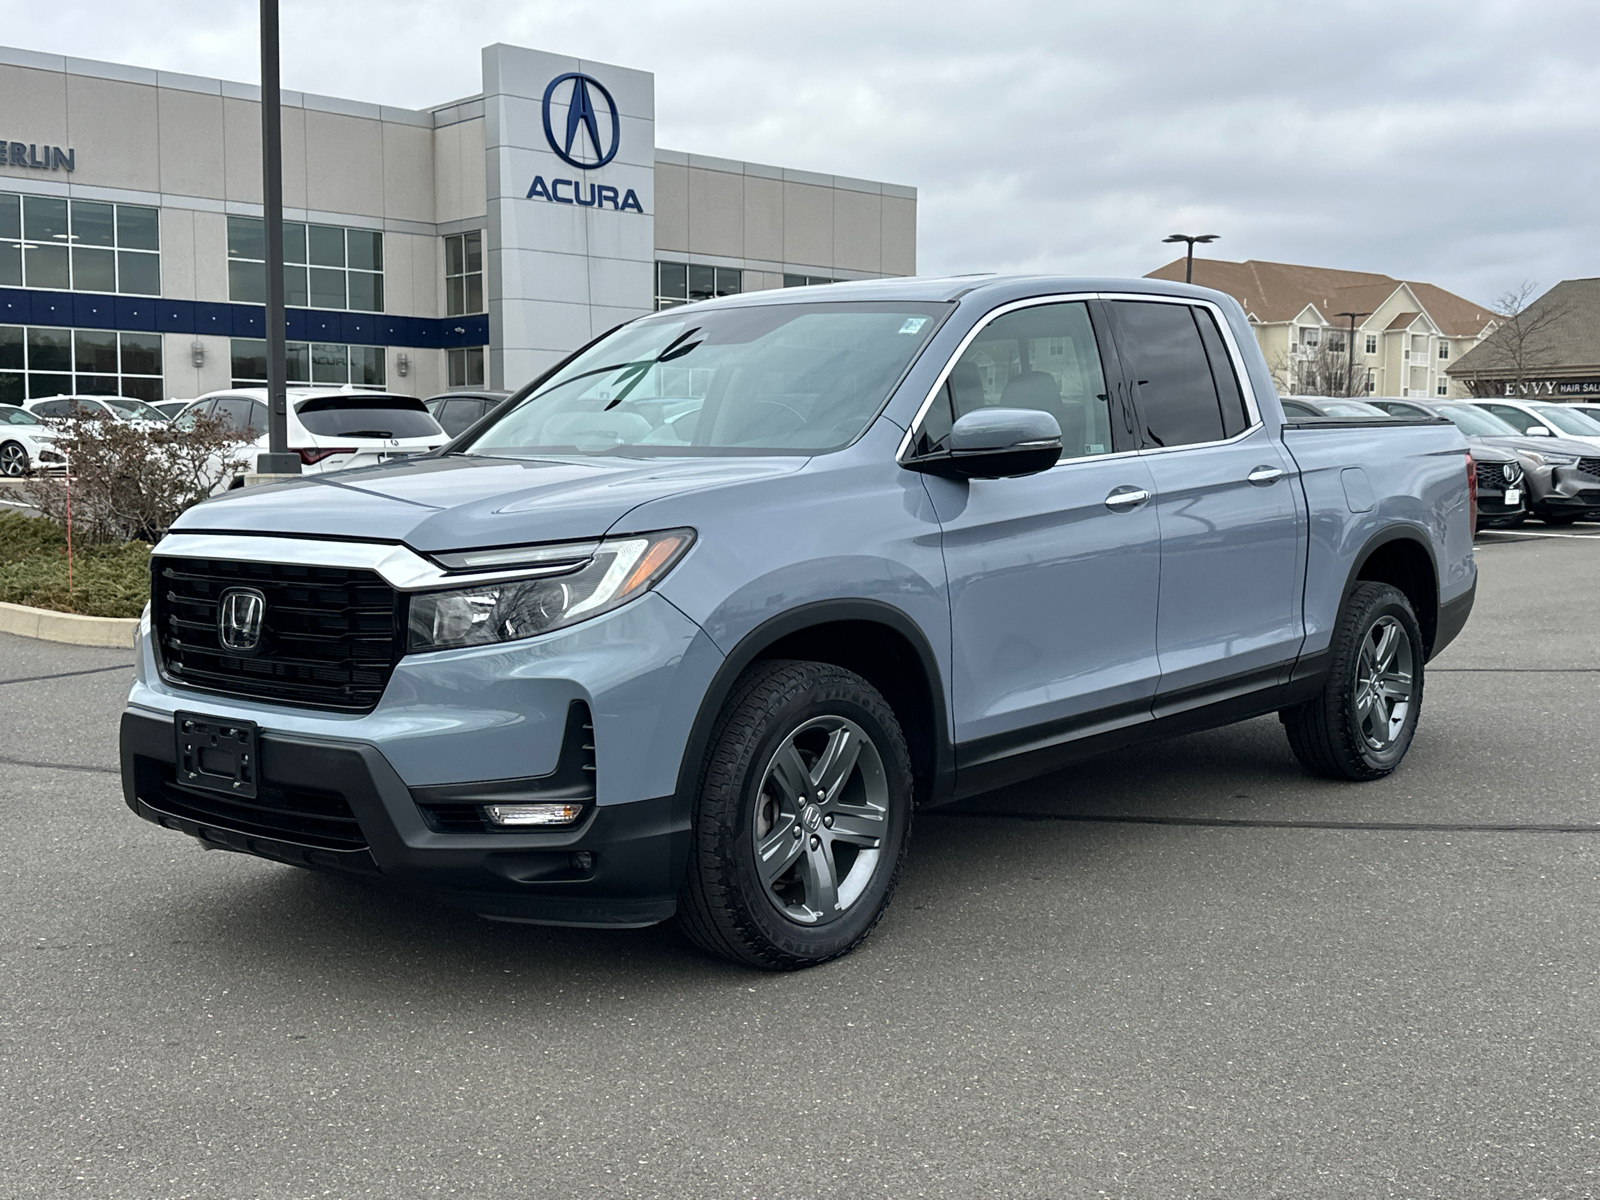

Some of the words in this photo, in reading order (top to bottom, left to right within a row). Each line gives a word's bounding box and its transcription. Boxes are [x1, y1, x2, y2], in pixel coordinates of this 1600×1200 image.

[526, 175, 644, 213] ACURA
[1504, 381, 1558, 396] ENVY
[1560, 384, 1580, 393] HAIR
